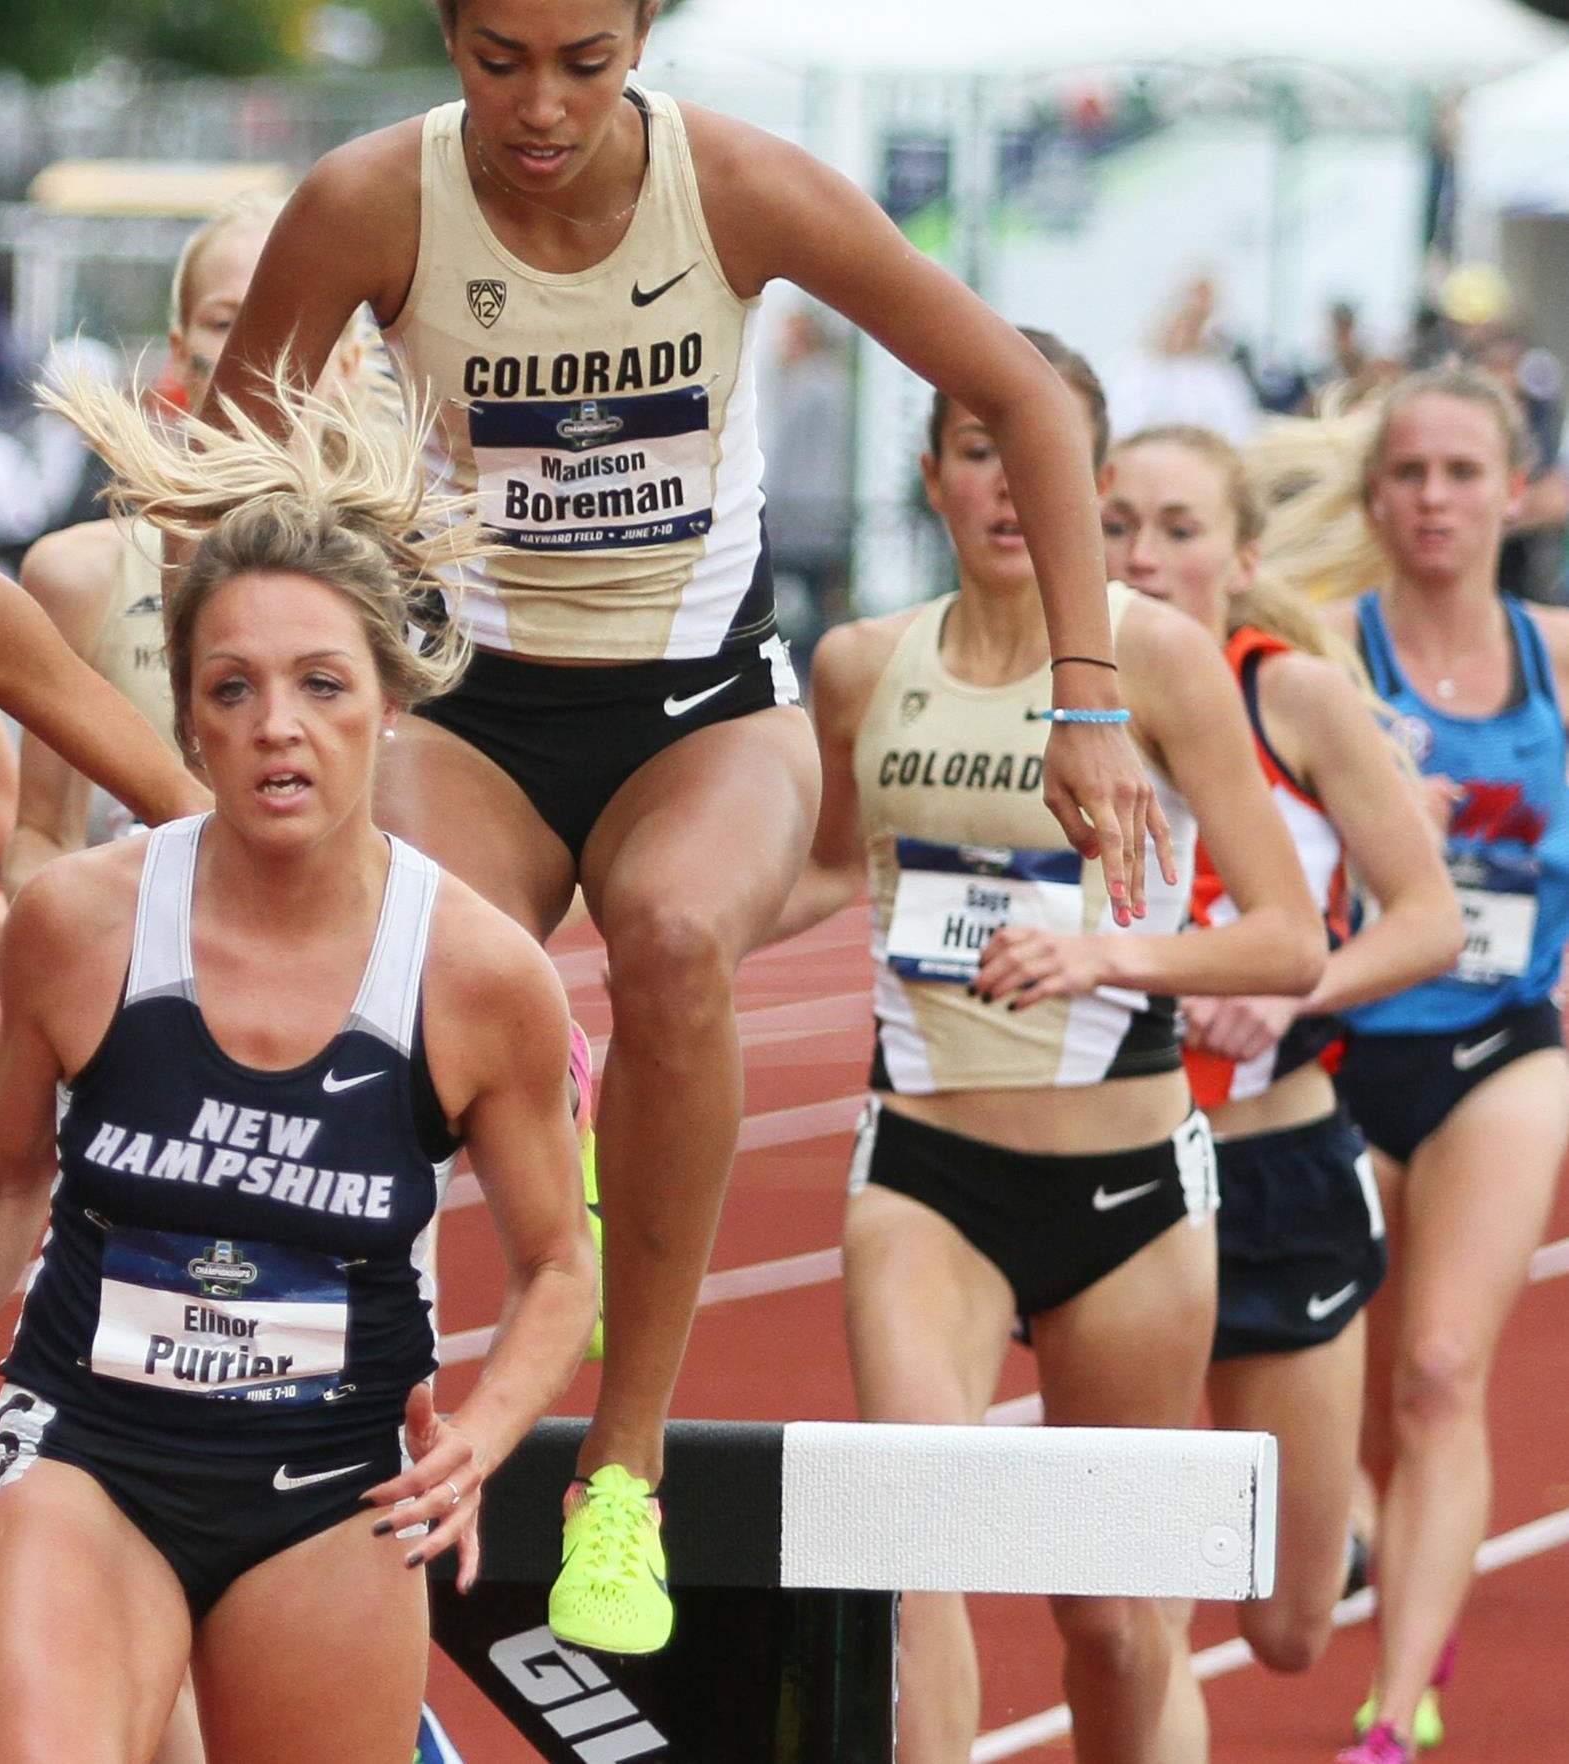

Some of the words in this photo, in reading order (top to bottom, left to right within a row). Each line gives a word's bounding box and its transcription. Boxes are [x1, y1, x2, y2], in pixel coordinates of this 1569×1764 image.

[477, 301, 496, 318] 12
[463, 331, 703, 398] COLORADO
[540, 451, 646, 483] Madison
[505, 475, 684, 523] Boreman
[520, 533, 572, 544] HAYWARD
[574, 531, 603, 542] FIELD
[621, 528, 649, 539] JUNE
[652, 523, 673, 536] 7-10
[880, 751, 1043, 791] COLORAD
[943, 914, 1007, 950] Hu
[189, 1097, 321, 1160] NEW
[83, 1122, 396, 1220] HAMPSHIRE
[184, 1304, 259, 1339] Elinor
[144, 1334, 294, 1384] Purrier
[274, 1384, 296, 1400] 7-10
